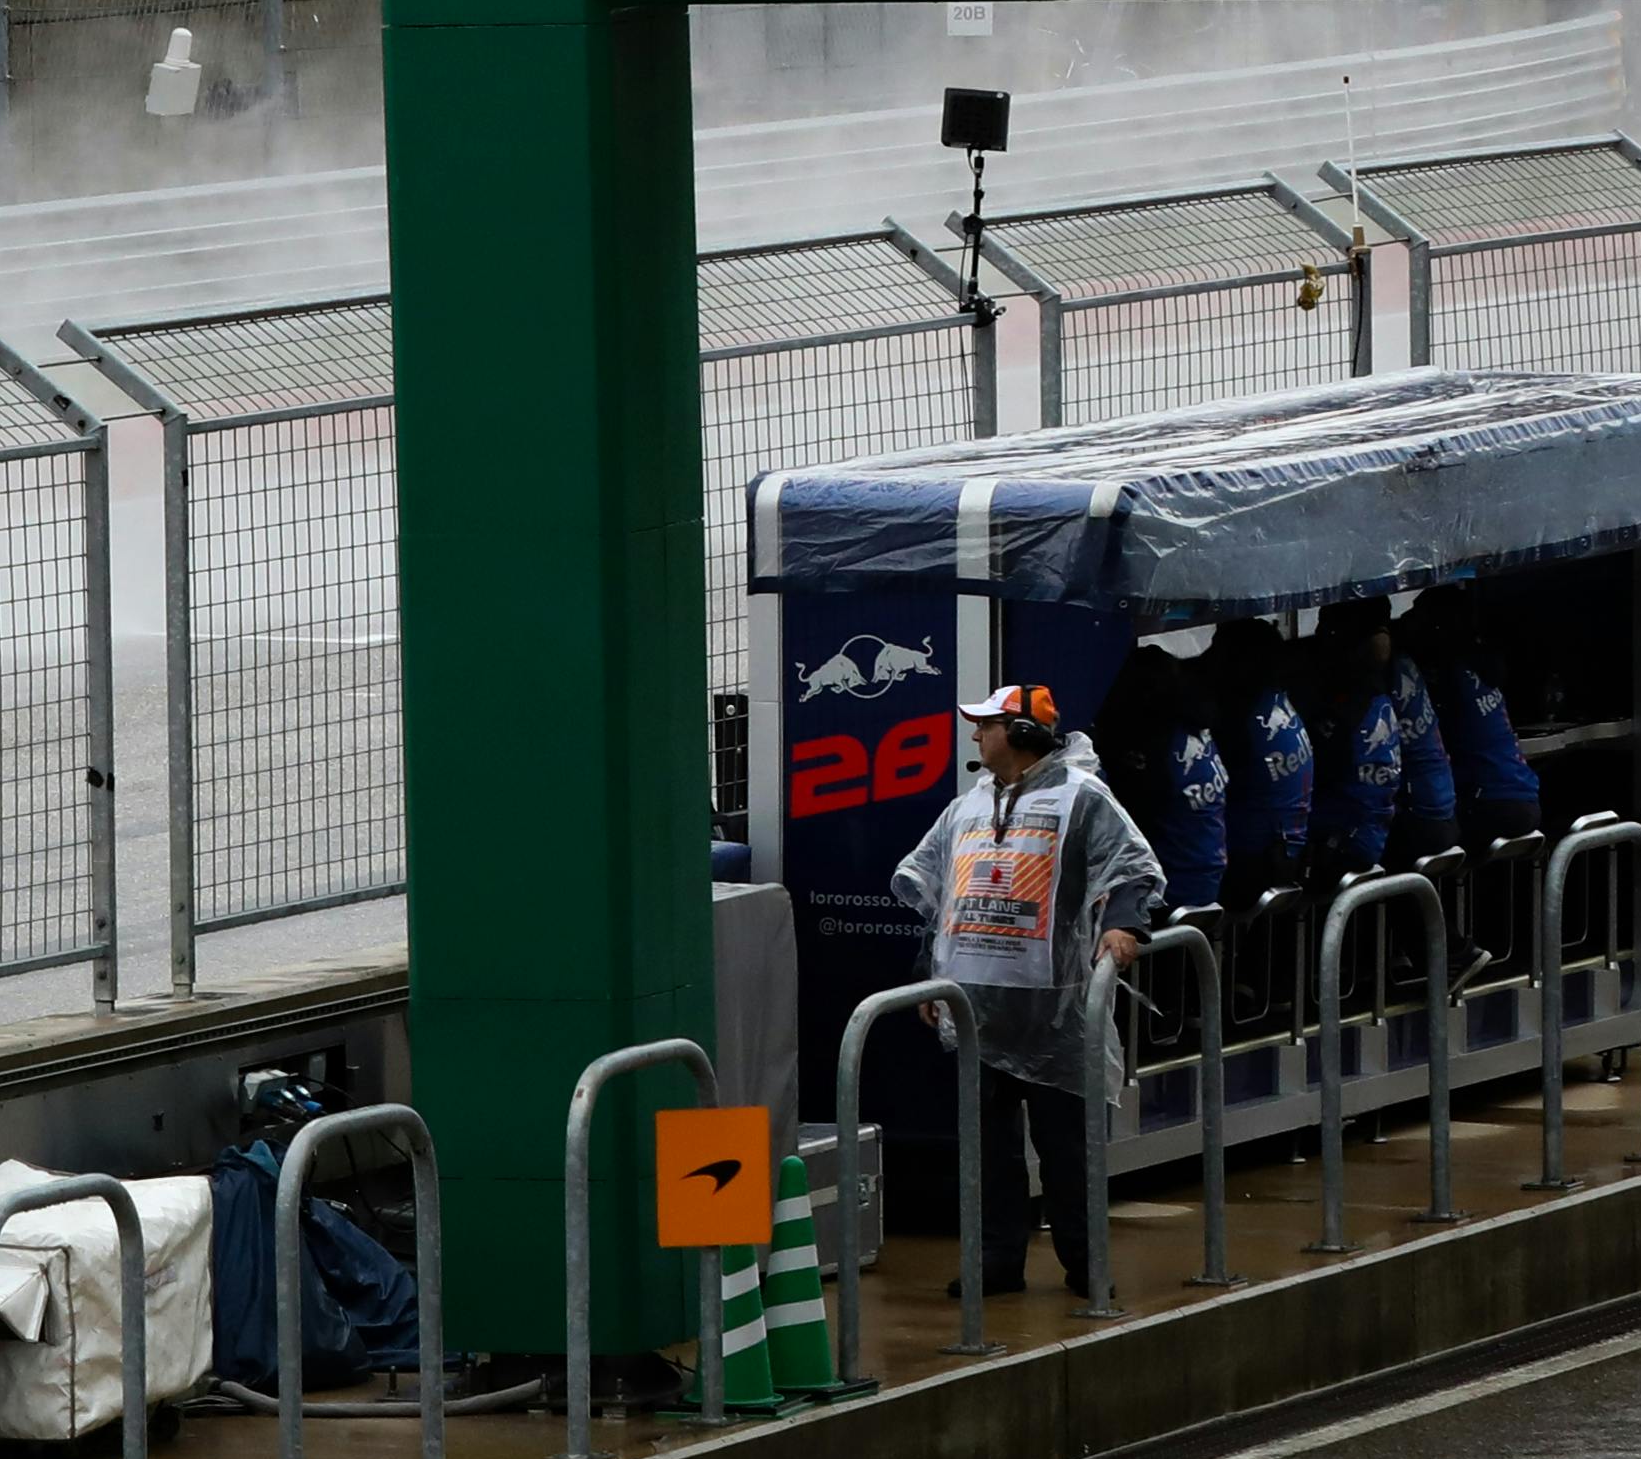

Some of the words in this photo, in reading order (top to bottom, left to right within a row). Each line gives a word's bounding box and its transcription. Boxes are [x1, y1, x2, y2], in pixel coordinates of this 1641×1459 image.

[953, 5, 985, 21] 20B
[791, 712, 952, 818] 28
[980, 899, 1023, 914] LANE
